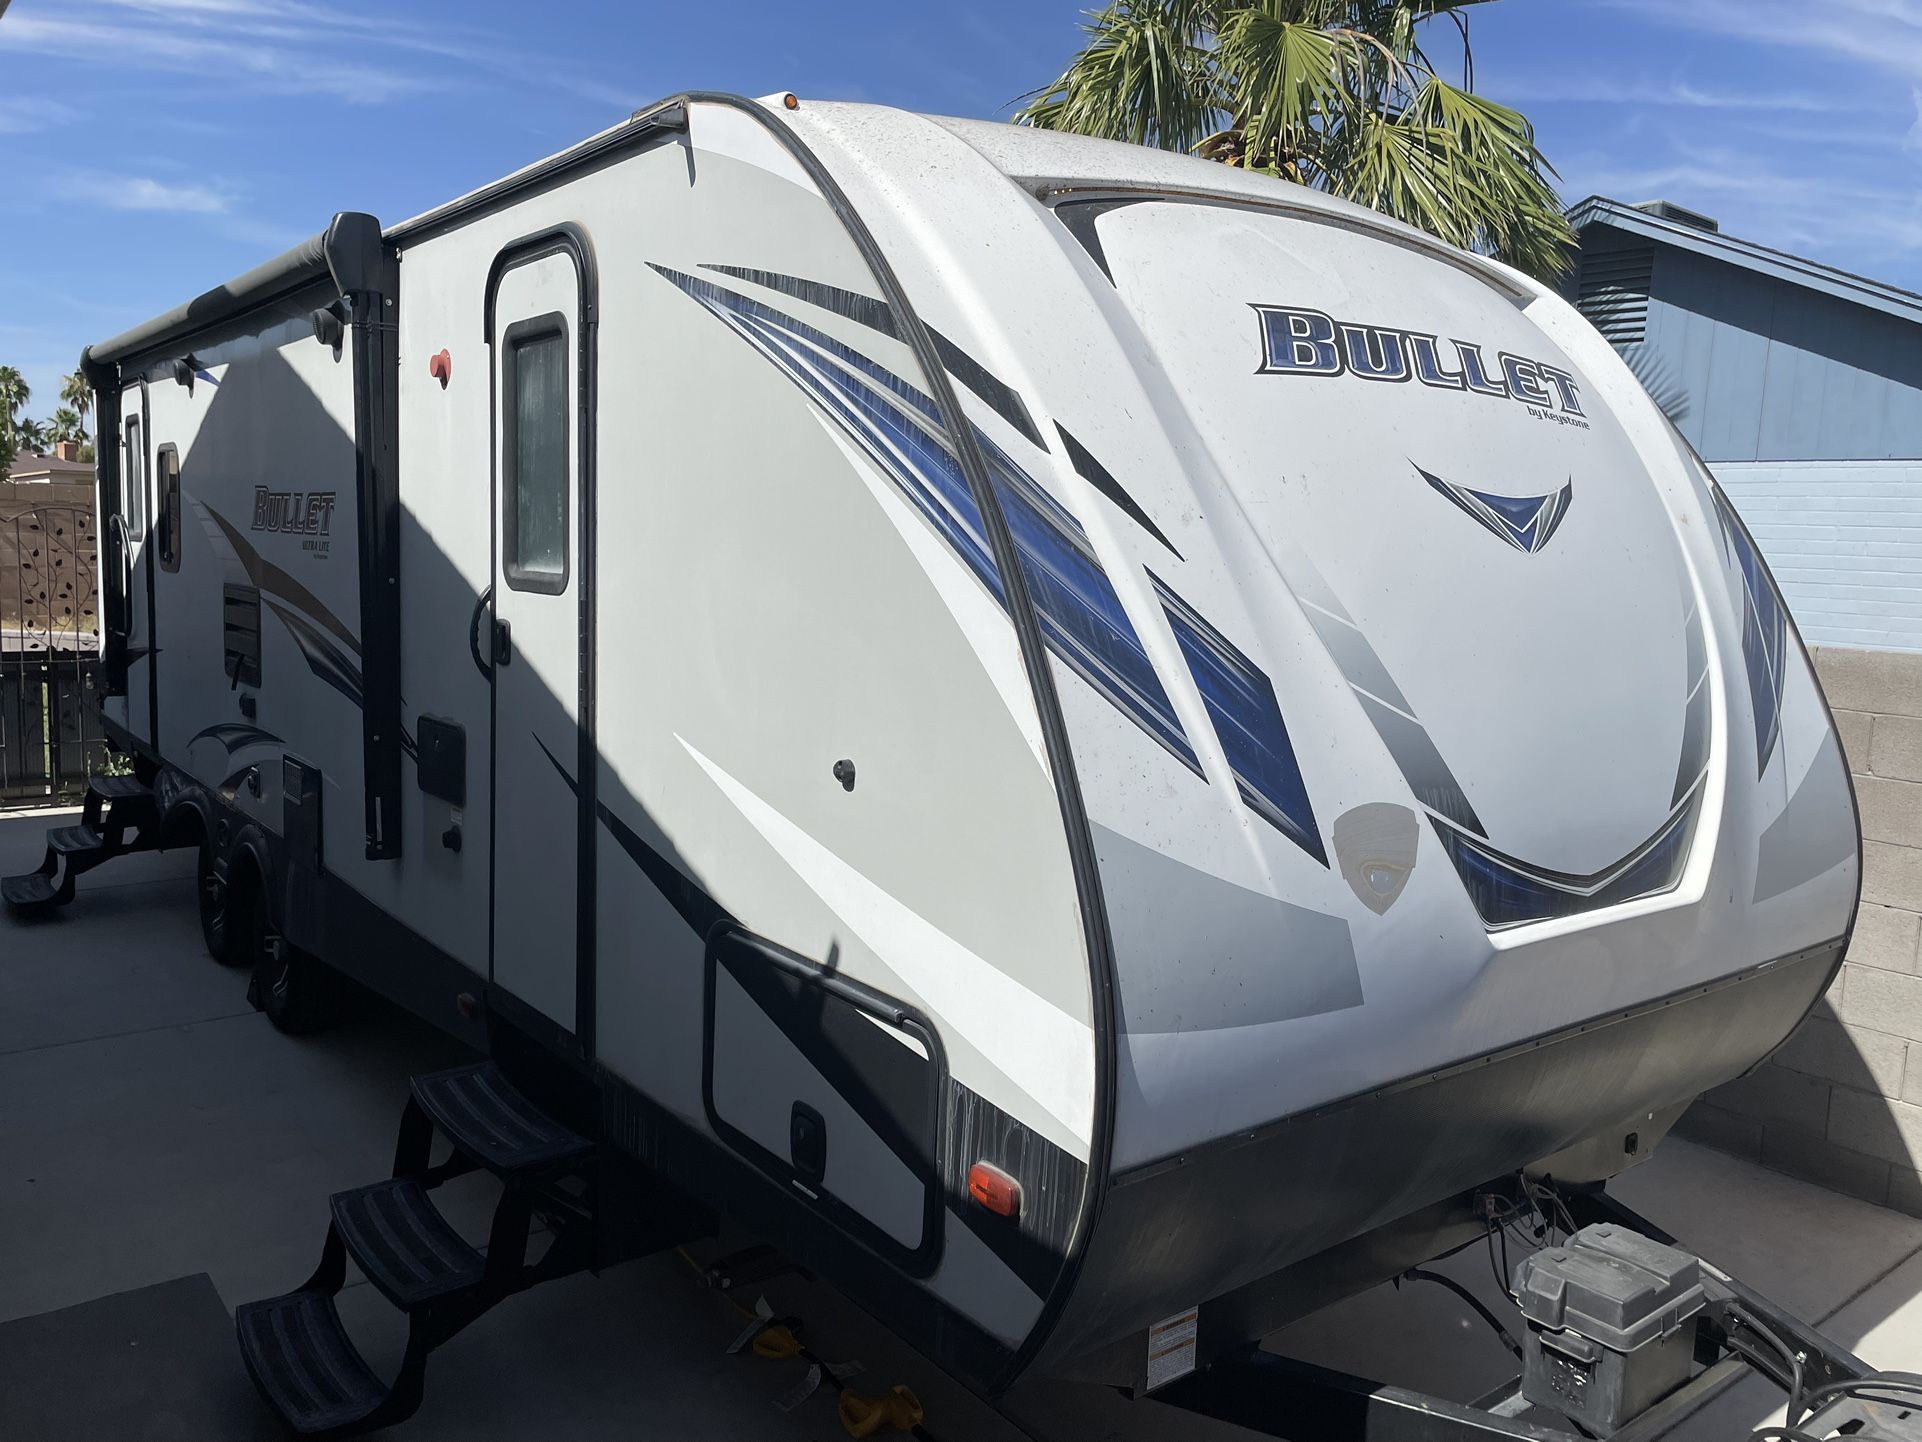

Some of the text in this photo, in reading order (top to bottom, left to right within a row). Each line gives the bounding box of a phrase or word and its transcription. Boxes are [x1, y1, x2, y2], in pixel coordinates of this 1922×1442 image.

[1245, 302, 1588, 419] BULLET
[1526, 405, 1591, 431] by Keystone
[251, 485, 336, 537] BULLET
